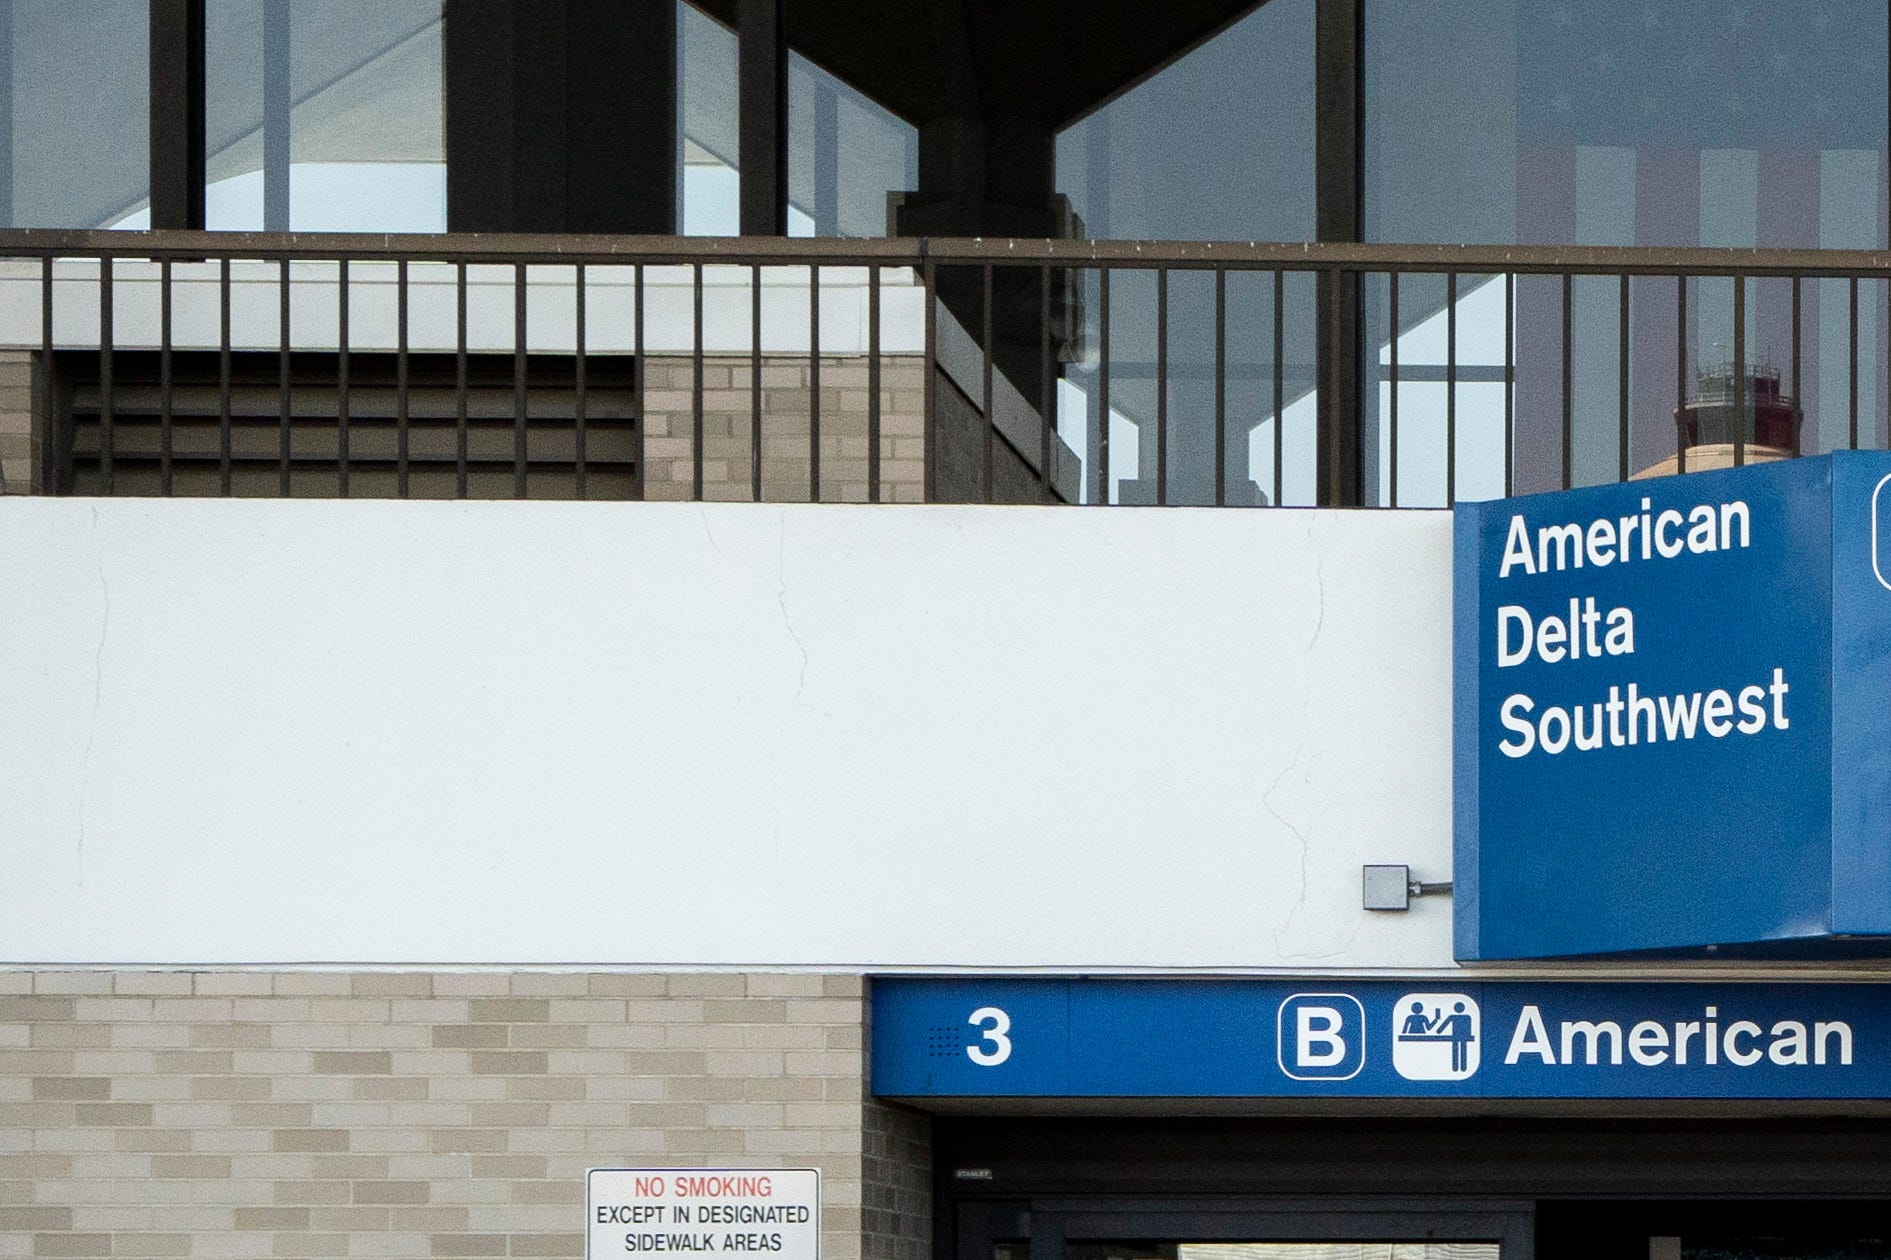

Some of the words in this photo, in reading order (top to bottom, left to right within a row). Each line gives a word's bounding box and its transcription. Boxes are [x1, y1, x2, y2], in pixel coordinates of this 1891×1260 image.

[1498, 497, 1751, 578] American
[1497, 596, 1636, 668] Delta
[1498, 667, 1789, 759] Southwest
[965, 1006, 1013, 1067] 3
[1296, 1006, 1347, 1067] B
[1505, 1006, 1853, 1067] American
[597, 1206, 665, 1224] EXCEPT
[673, 1206, 690, 1224] IN
[699, 1206, 809, 1224] DESIGNATED
[635, 1177, 664, 1197] NO
[675, 1177, 771, 1197] SMOKING
[625, 1233, 714, 1251] SIDEWALK
[723, 1233, 782, 1251] AREAS
